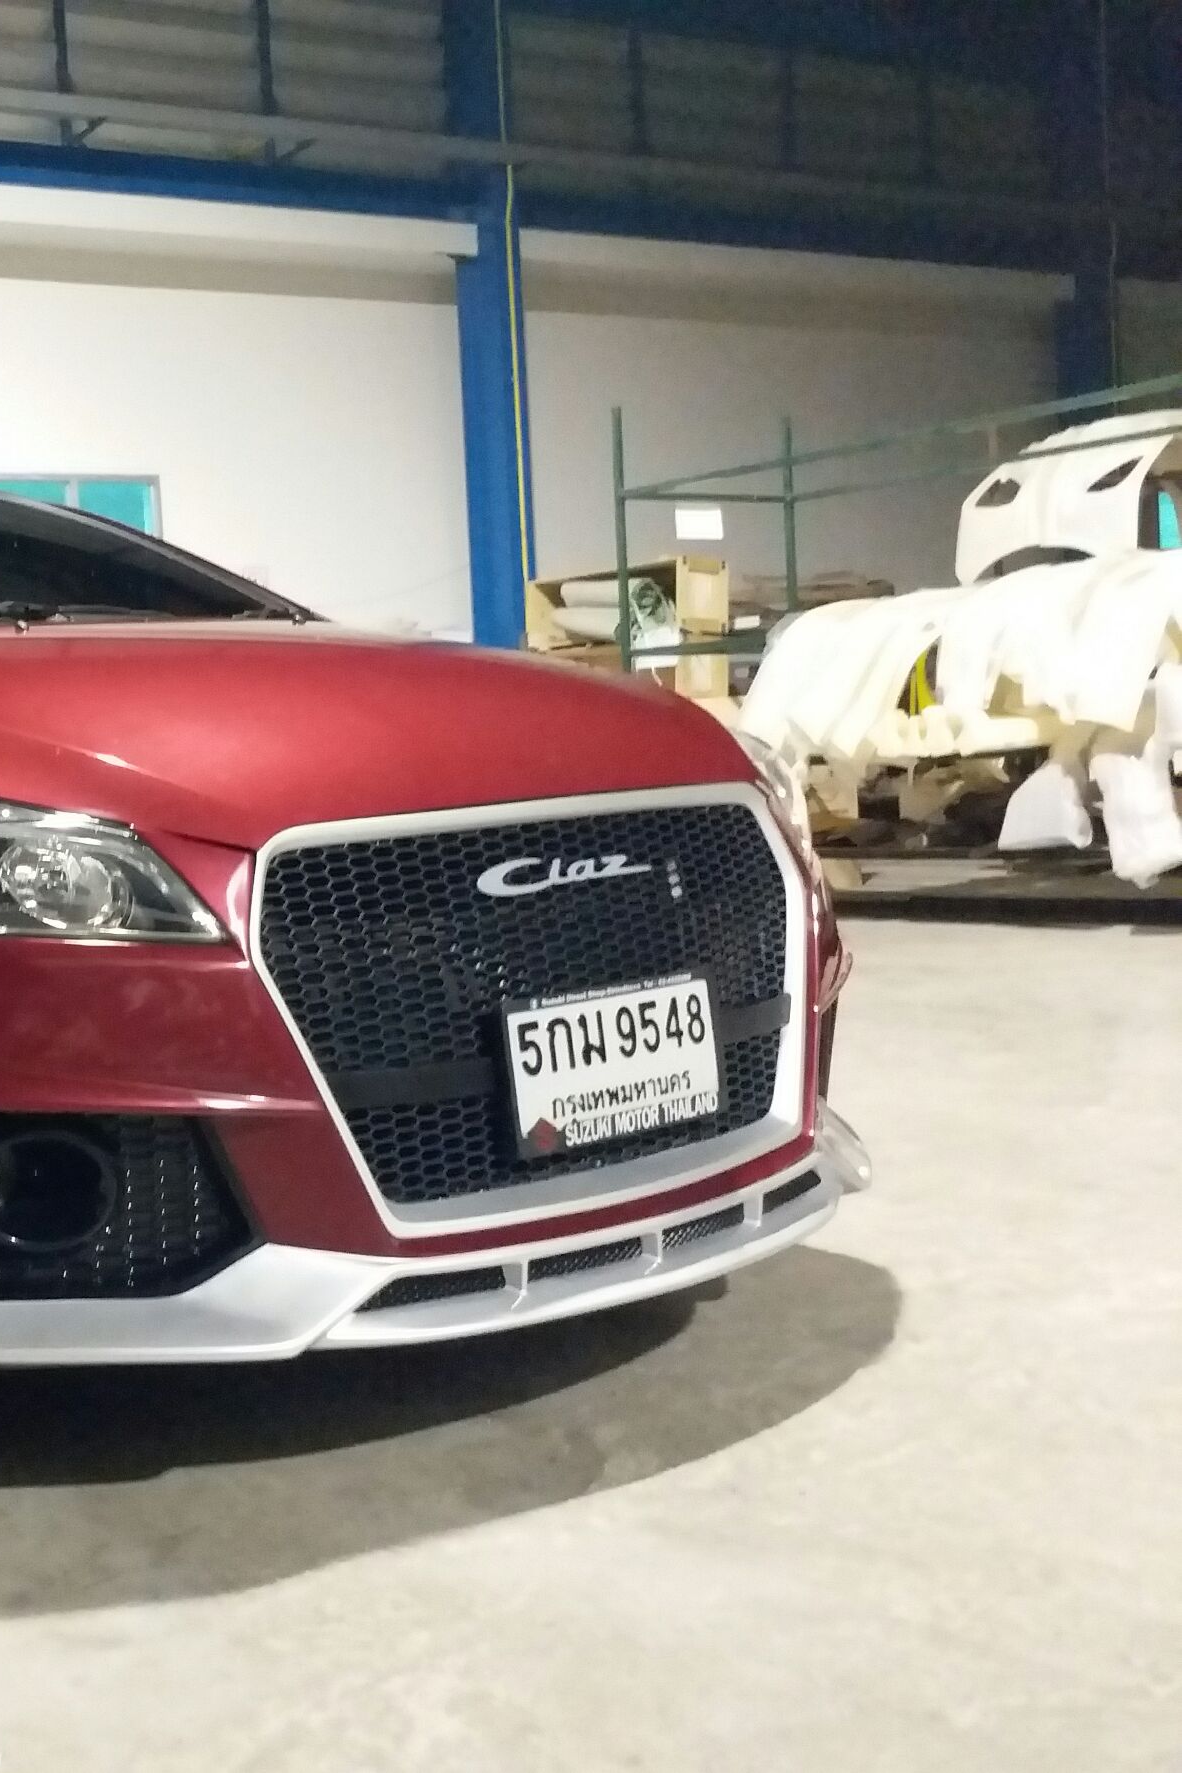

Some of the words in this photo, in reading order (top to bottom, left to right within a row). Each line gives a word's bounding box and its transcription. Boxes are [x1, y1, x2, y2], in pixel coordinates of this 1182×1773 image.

[517, 1010, 607, 1076] 5กม
[616, 994, 706, 1057] 9548
[565, 1115, 612, 1147] SUZUKI
[615, 1104, 660, 1134] MOTOR
[663, 1090, 718, 1123] THAILAND
